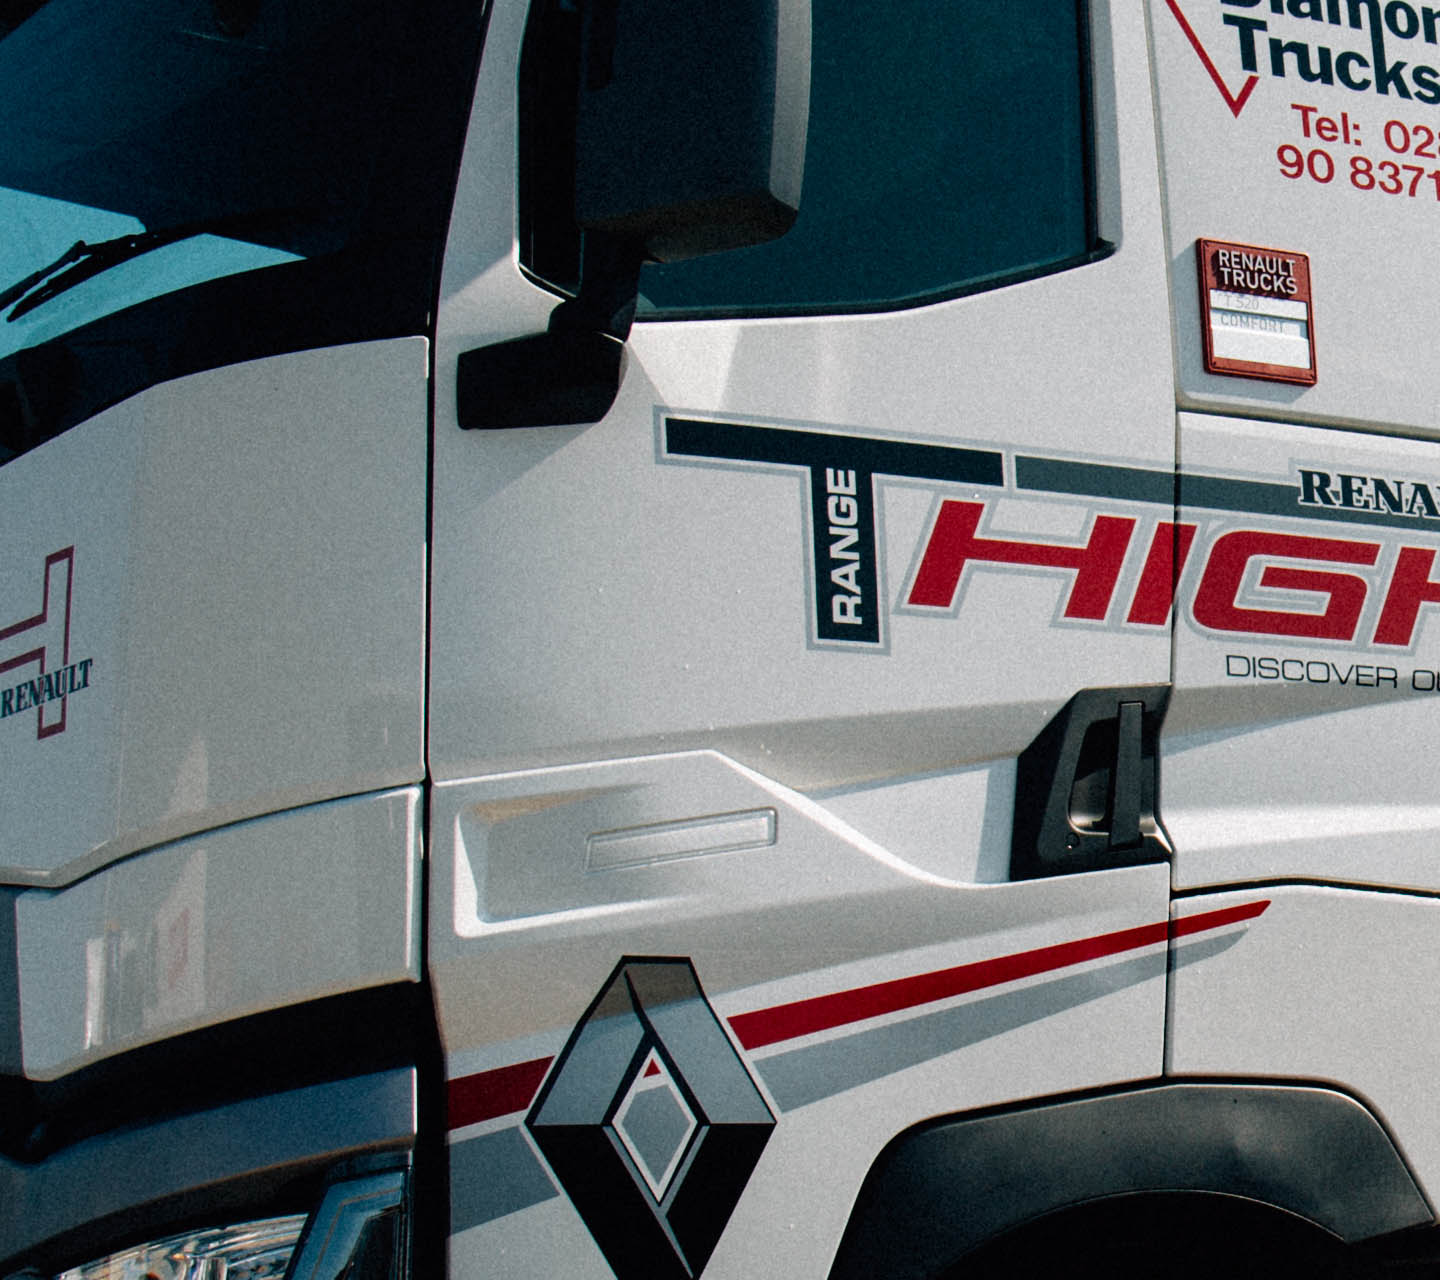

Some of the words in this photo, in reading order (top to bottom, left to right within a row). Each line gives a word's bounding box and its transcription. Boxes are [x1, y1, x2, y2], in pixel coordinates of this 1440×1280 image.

[1290, 103, 1362, 147] Tel:
[1276, 144, 1336, 185] 90
[1218, 249, 1297, 277] RENAULT
[1220, 267, 1298, 295] TRUCKS
[826, 466, 863, 625] RANGE
[0, 658, 93, 719] RENAULT
[1225, 654, 1399, 689] DISCOVER
